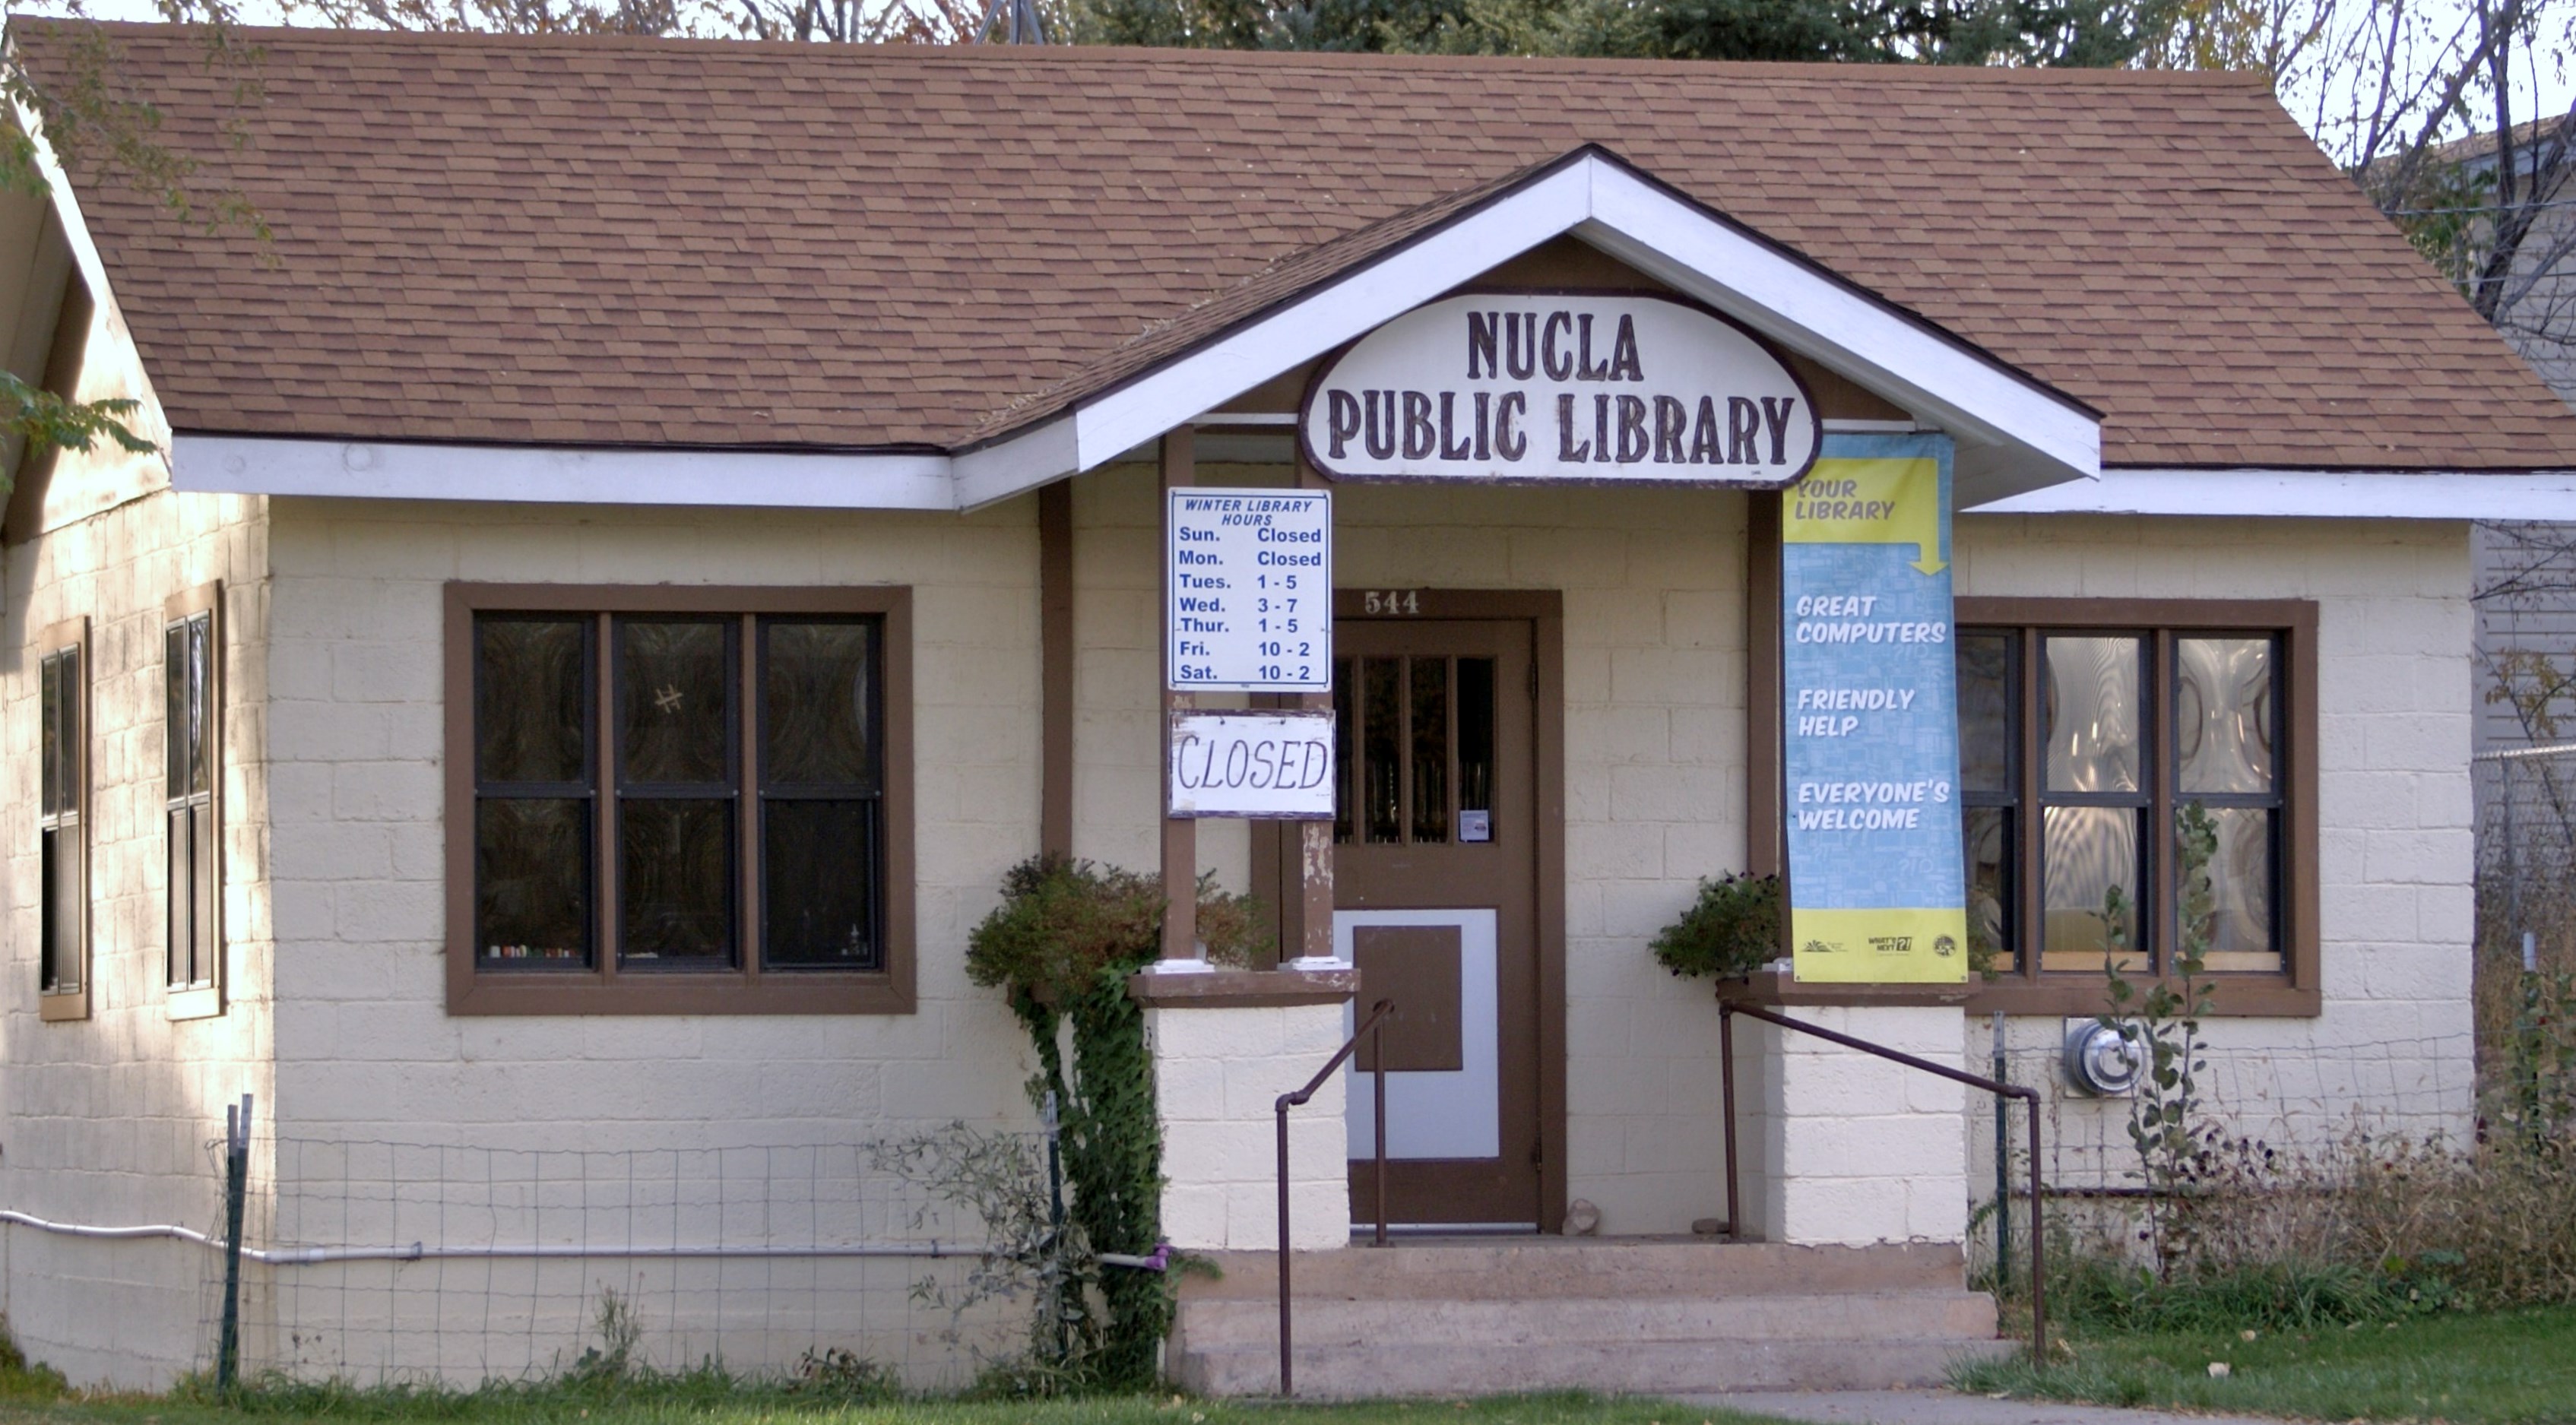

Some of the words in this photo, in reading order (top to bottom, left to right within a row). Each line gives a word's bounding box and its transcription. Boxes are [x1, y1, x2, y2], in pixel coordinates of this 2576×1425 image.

[1467, 311, 1644, 382] NUCLA
[1327, 389, 1527, 461] PUBLIC
[1557, 393, 1795, 465] LIBRARY
[1796, 480, 1857, 498] YOUR
[1185, 499, 1241, 511] WINTER
[1247, 500, 1312, 512] LIBRARY
[1795, 501, 1895, 520] LIBRARY
[1221, 515, 1272, 526] HOURS
[1179, 527, 1220, 541] Sun.
[1257, 527, 1321, 543] Closed
[1179, 550, 1223, 565] Mon.
[1257, 551, 1321, 566] Closed
[1180, 574, 1231, 589] Tues.
[1180, 597, 1225, 612] Wed.
[1365, 591, 1419, 614] 544
[1796, 595, 1877, 617] GREAT
[1180, 618, 1229, 632] Thur.
[1796, 622, 1947, 644] COMPUTERS
[1180, 641, 1210, 656] Fri.
[1180, 665, 1217, 679] Sat.
[1798, 689, 1915, 710] FRIENDLY
[1799, 715, 1858, 736] HELP
[1179, 735, 1327, 789] CLOSED
[1798, 779, 1950, 803] EVERYONE'S
[1798, 808, 1920, 830] WELCOME
